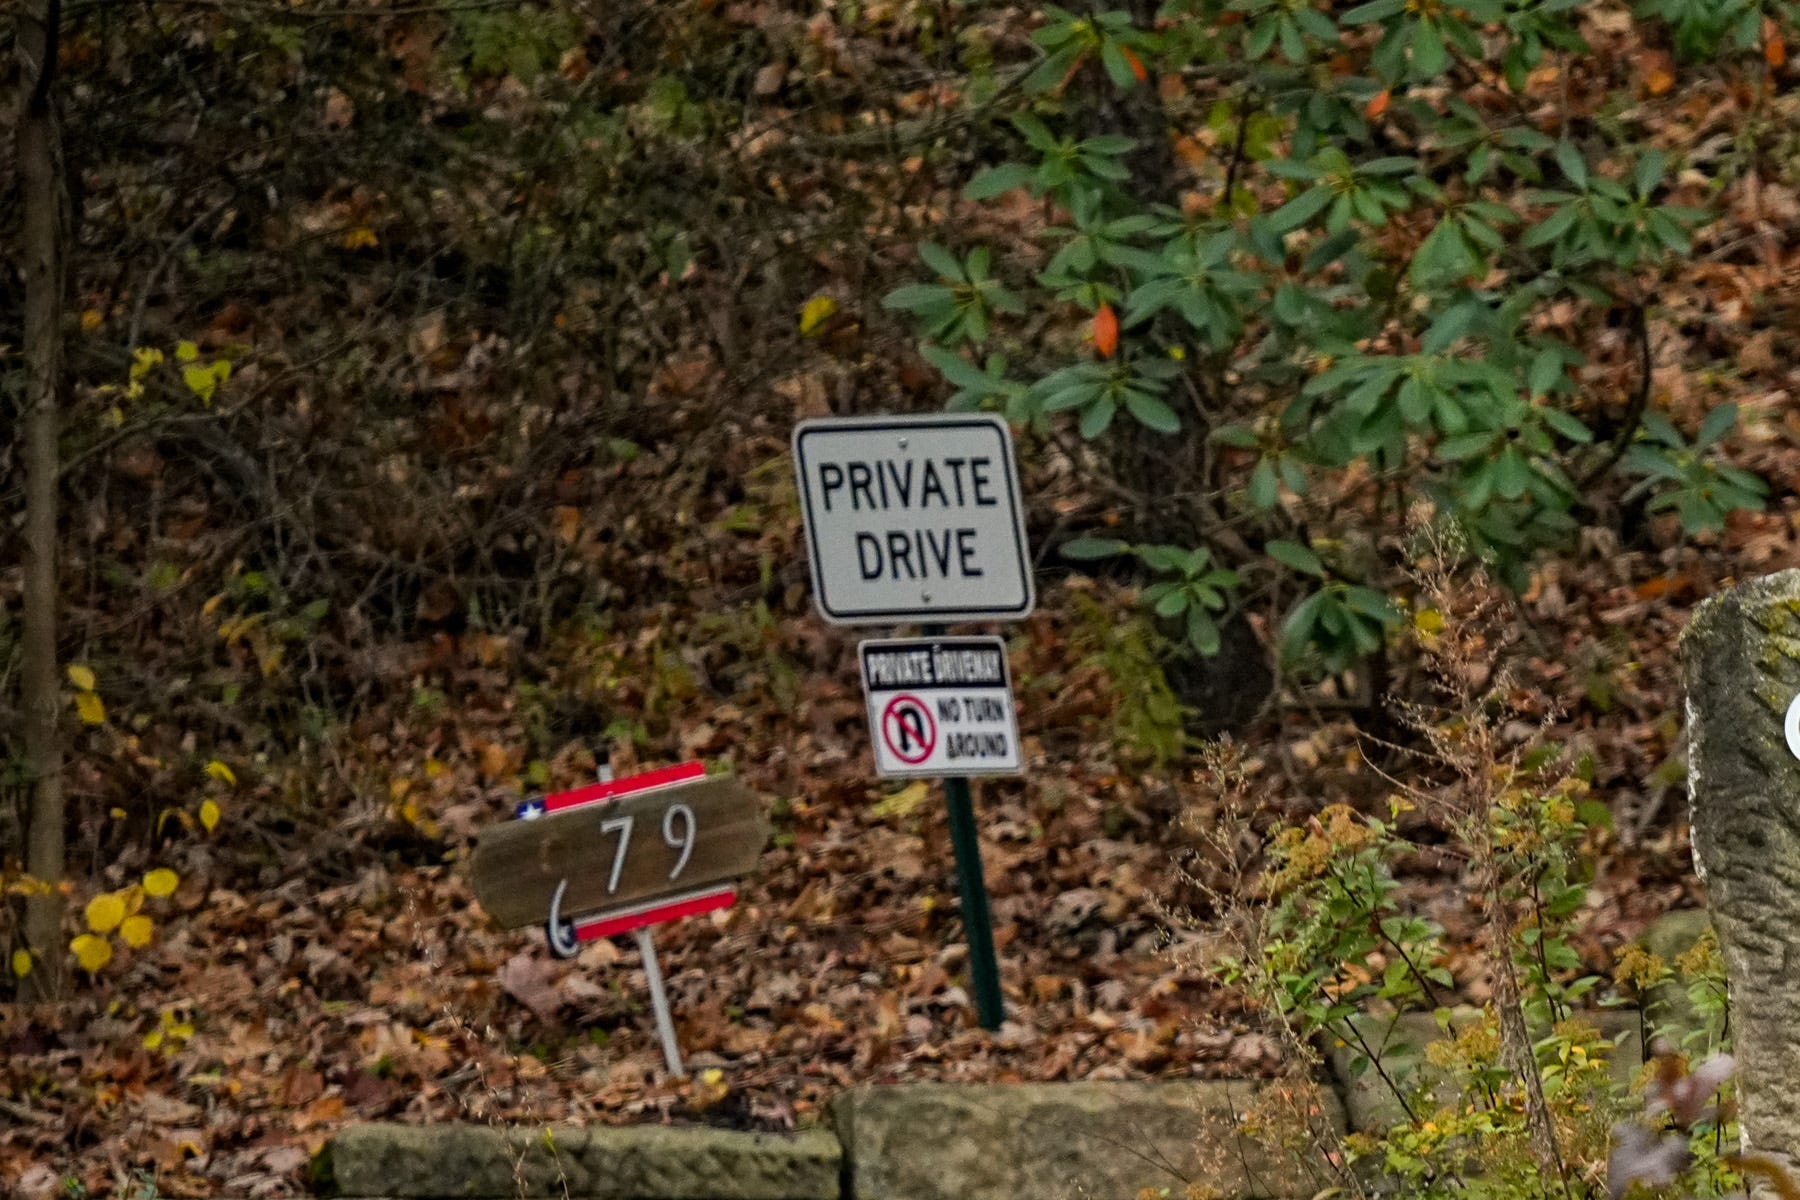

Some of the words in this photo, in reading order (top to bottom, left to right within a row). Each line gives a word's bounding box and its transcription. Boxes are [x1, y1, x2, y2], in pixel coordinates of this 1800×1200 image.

[819, 456, 997, 511] PRIVATE
[855, 527, 984, 580] DRIVE
[937, 696, 960, 722] NO
[963, 695, 1005, 722] TURN
